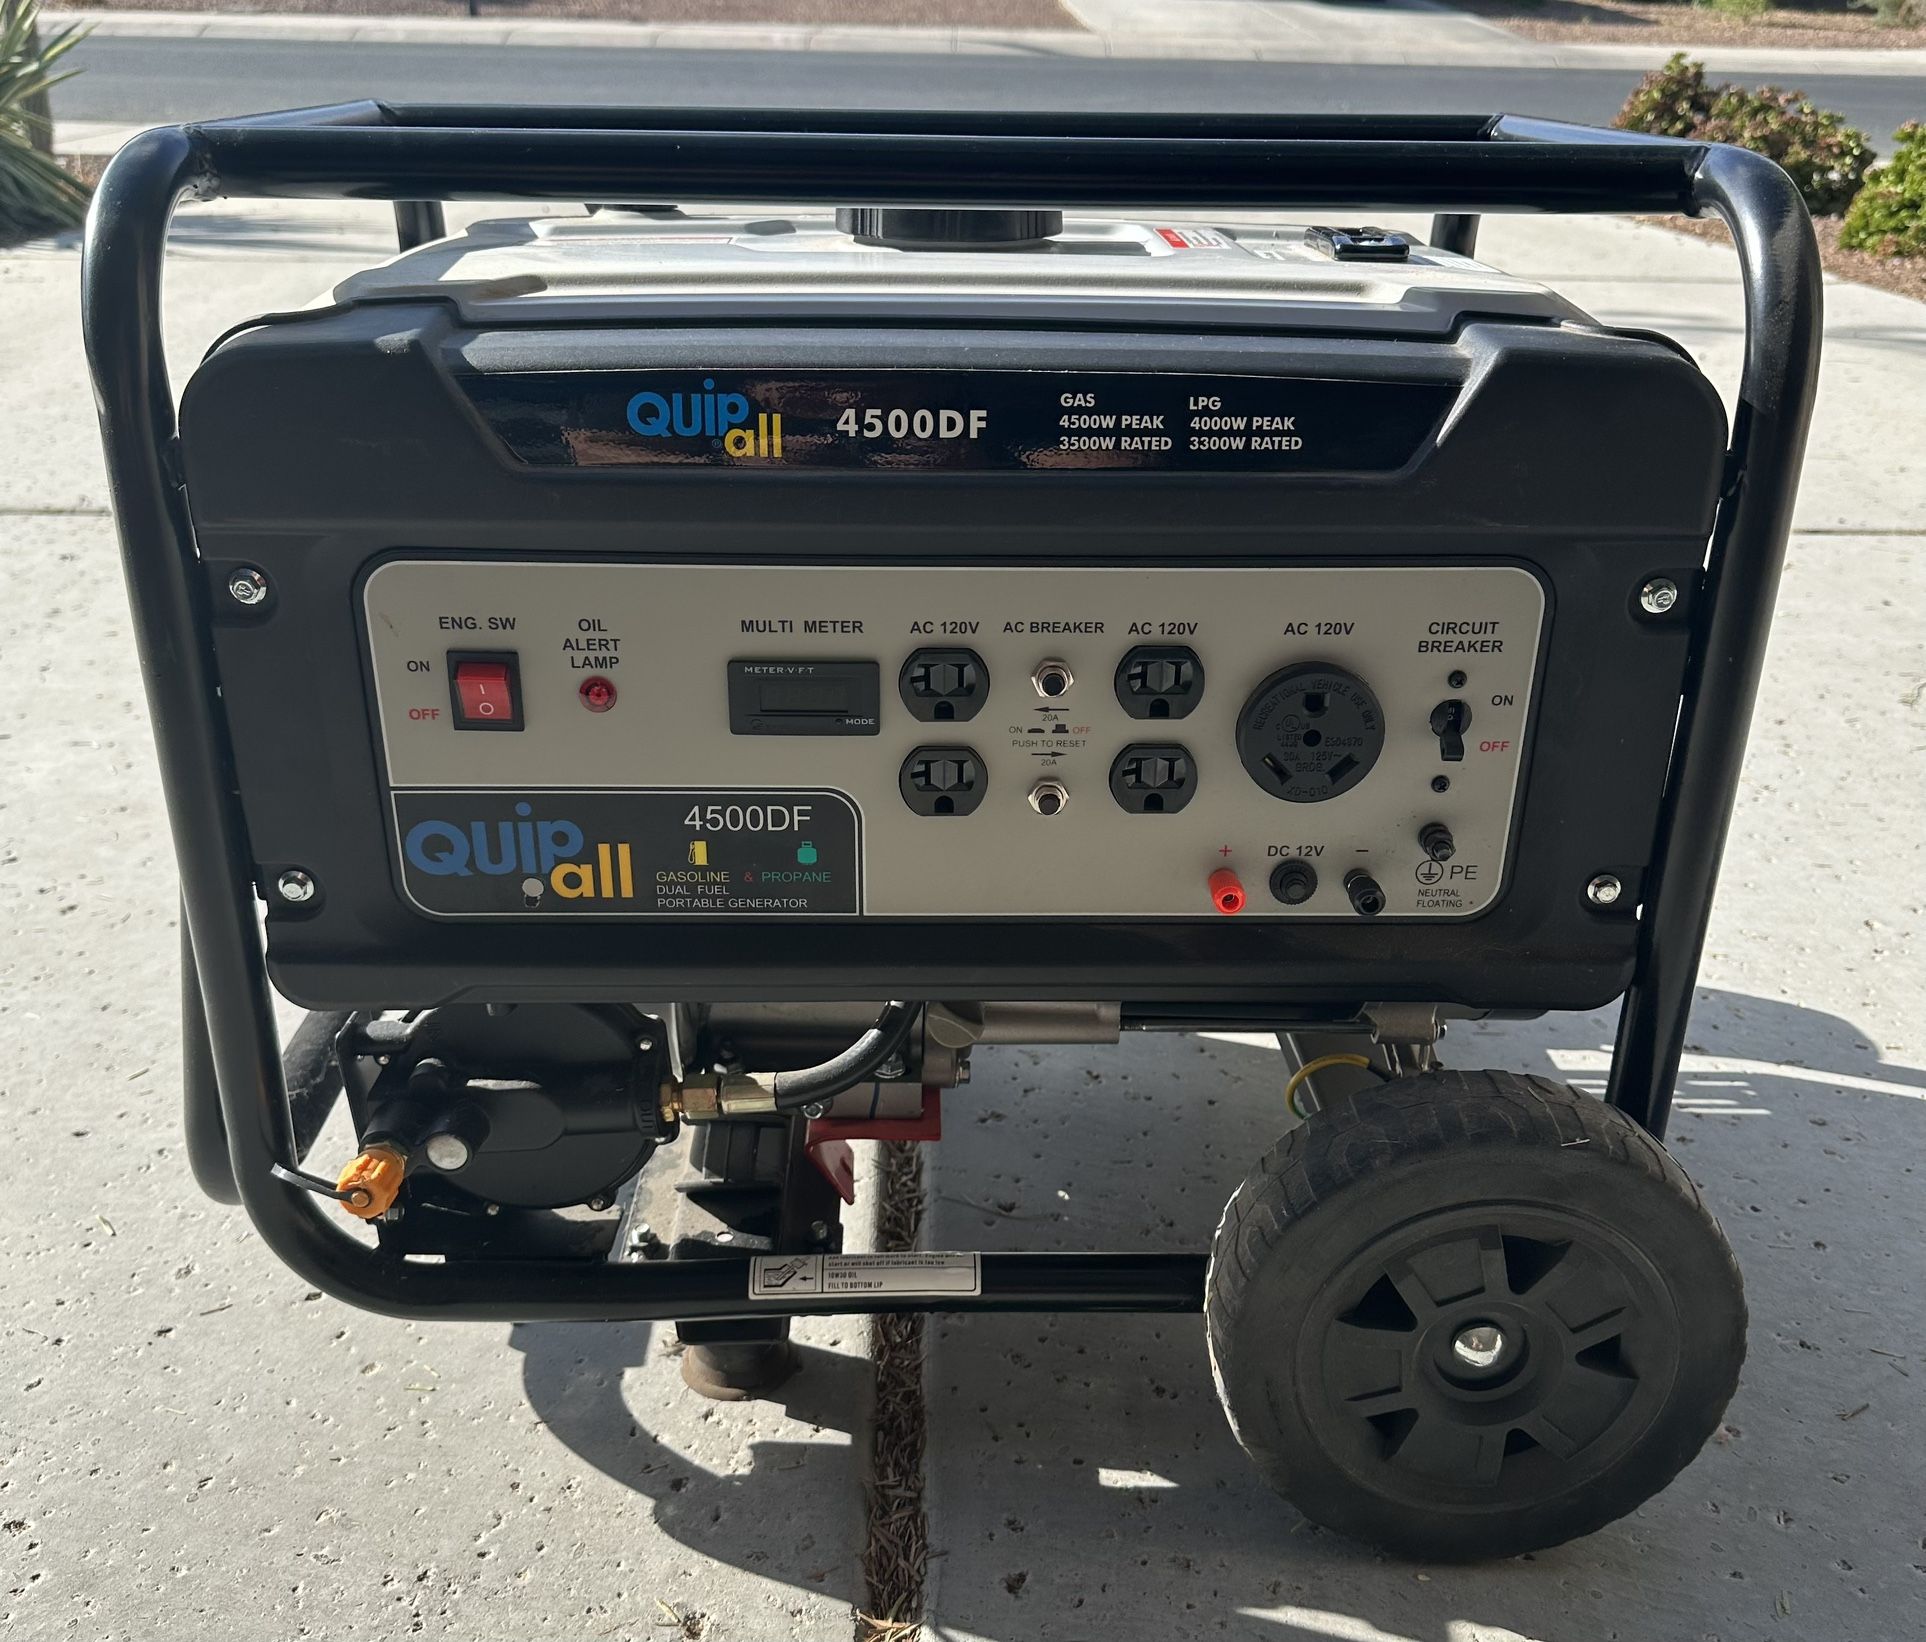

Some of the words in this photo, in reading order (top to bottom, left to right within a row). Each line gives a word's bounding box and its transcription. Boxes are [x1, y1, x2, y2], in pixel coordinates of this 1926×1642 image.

[1060, 393, 1095, 407] GAS
[1189, 397, 1222, 411] LPG
[627, 378, 749, 438] Quip
[836, 408, 988, 439] 4500DF
[1059, 415, 1117, 429] 4500W
[1121, 415, 1165, 429] PEAK
[1189, 417, 1247, 431] 4000W
[1251, 417, 1295, 431] PEAK
[724, 413, 782, 458] all
[1059, 436, 1117, 451] 3500W
[1120, 436, 1173, 451] RATED
[1189, 437, 1247, 451] 3300W
[1251, 437, 1303, 451] RATED
[439, 616, 483, 631] ENG.
[488, 616, 517, 631] SW
[578, 618, 608, 632] OIL
[741, 619, 794, 634] MULTI
[803, 619, 864, 634] METER
[910, 622, 934, 634] AC
[940, 621, 980, 634] 120V
[1003, 622, 1026, 633] AC
[1030, 622, 1105, 634] BREAKER
[1128, 623, 1152, 635] AC
[1158, 623, 1199, 635] 120V
[1284, 623, 1309, 635] AC
[1316, 623, 1355, 635] 120V
[1428, 622, 1500, 635] CIRCUIT
[562, 638, 621, 652] ALERT
[1417, 640, 1504, 653] BREAKER
[407, 660, 430, 673] ON
[571, 656, 620, 669] LAMP
[1311, 679, 1350, 696] VEHICLE
[1491, 695, 1514, 706] ON
[408, 708, 441, 721] OFF
[1042, 714, 1059, 722] 20A
[1009, 726, 1023, 734] ON
[1072, 726, 1091, 734] OFF
[1012, 740, 1039, 748] PUSH
[1056, 740, 1087, 748] RESET
[1479, 741, 1511, 752] OFF
[684, 805, 813, 831] 4500DF
[405, 802, 584, 876] Quip
[1267, 846, 1290, 857] DC
[1296, 846, 1325, 857] 12V
[551, 843, 634, 898] all
[656, 871, 730, 883] GASOLINE
[744, 871, 753, 883] &
[762, 871, 832, 883] PROPANE
[1450, 865, 1478, 880] PE
[657, 885, 691, 895] DUAL
[698, 885, 730, 895] FUEL
[1417, 889, 1461, 897] NEUTRAL
[657, 898, 725, 908] PORTABLE
[728, 898, 808, 908] GENERATOR
[1416, 900, 1463, 908] FLOATING
[828, 1281, 840, 1289] FILL
[841, 1281, 848, 1289] TO
[850, 1281, 872, 1289] BOTTOM
[874, 1280, 883, 1289] LIP
